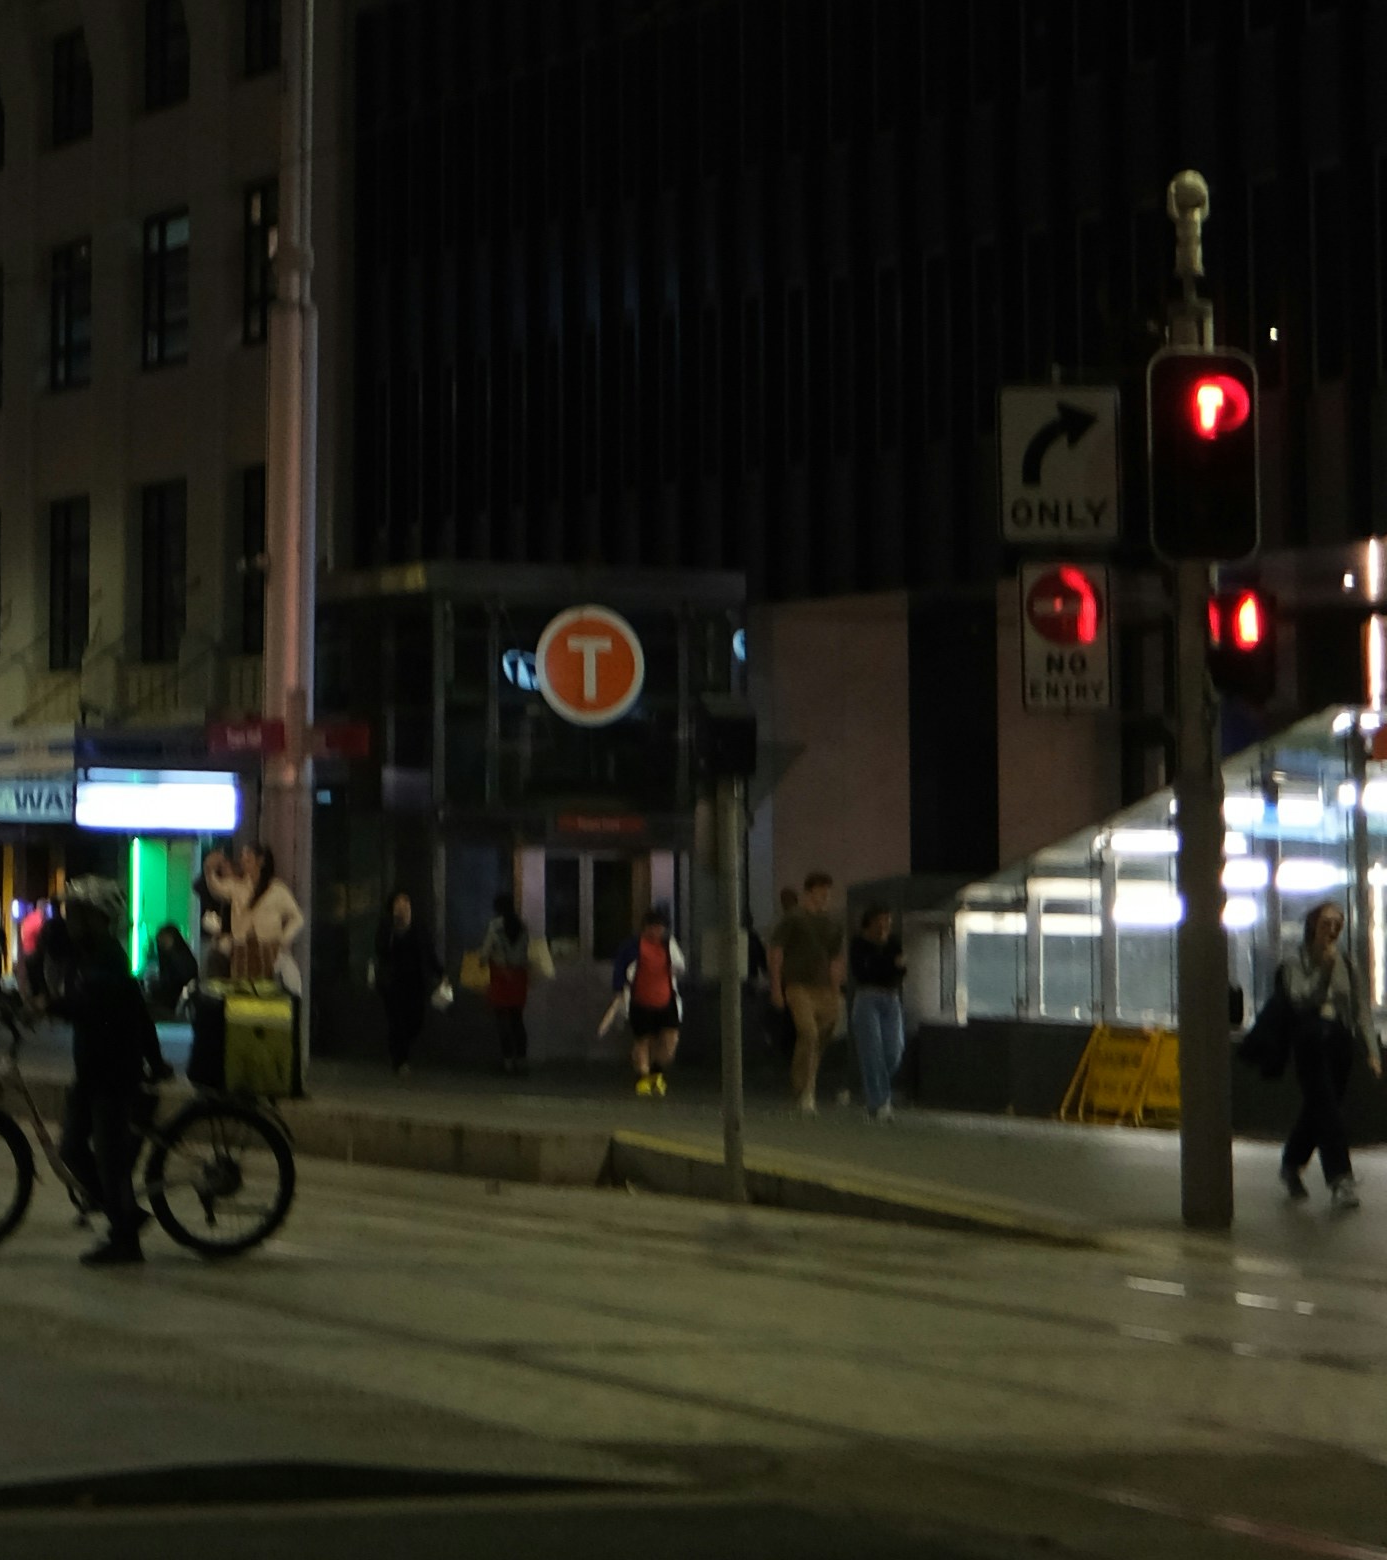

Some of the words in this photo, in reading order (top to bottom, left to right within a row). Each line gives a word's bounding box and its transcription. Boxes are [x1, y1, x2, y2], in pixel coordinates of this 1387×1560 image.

[1012, 496, 1107, 529] ONLY
[567, 635, 612, 703] T
[1047, 651, 1087, 676] NO
